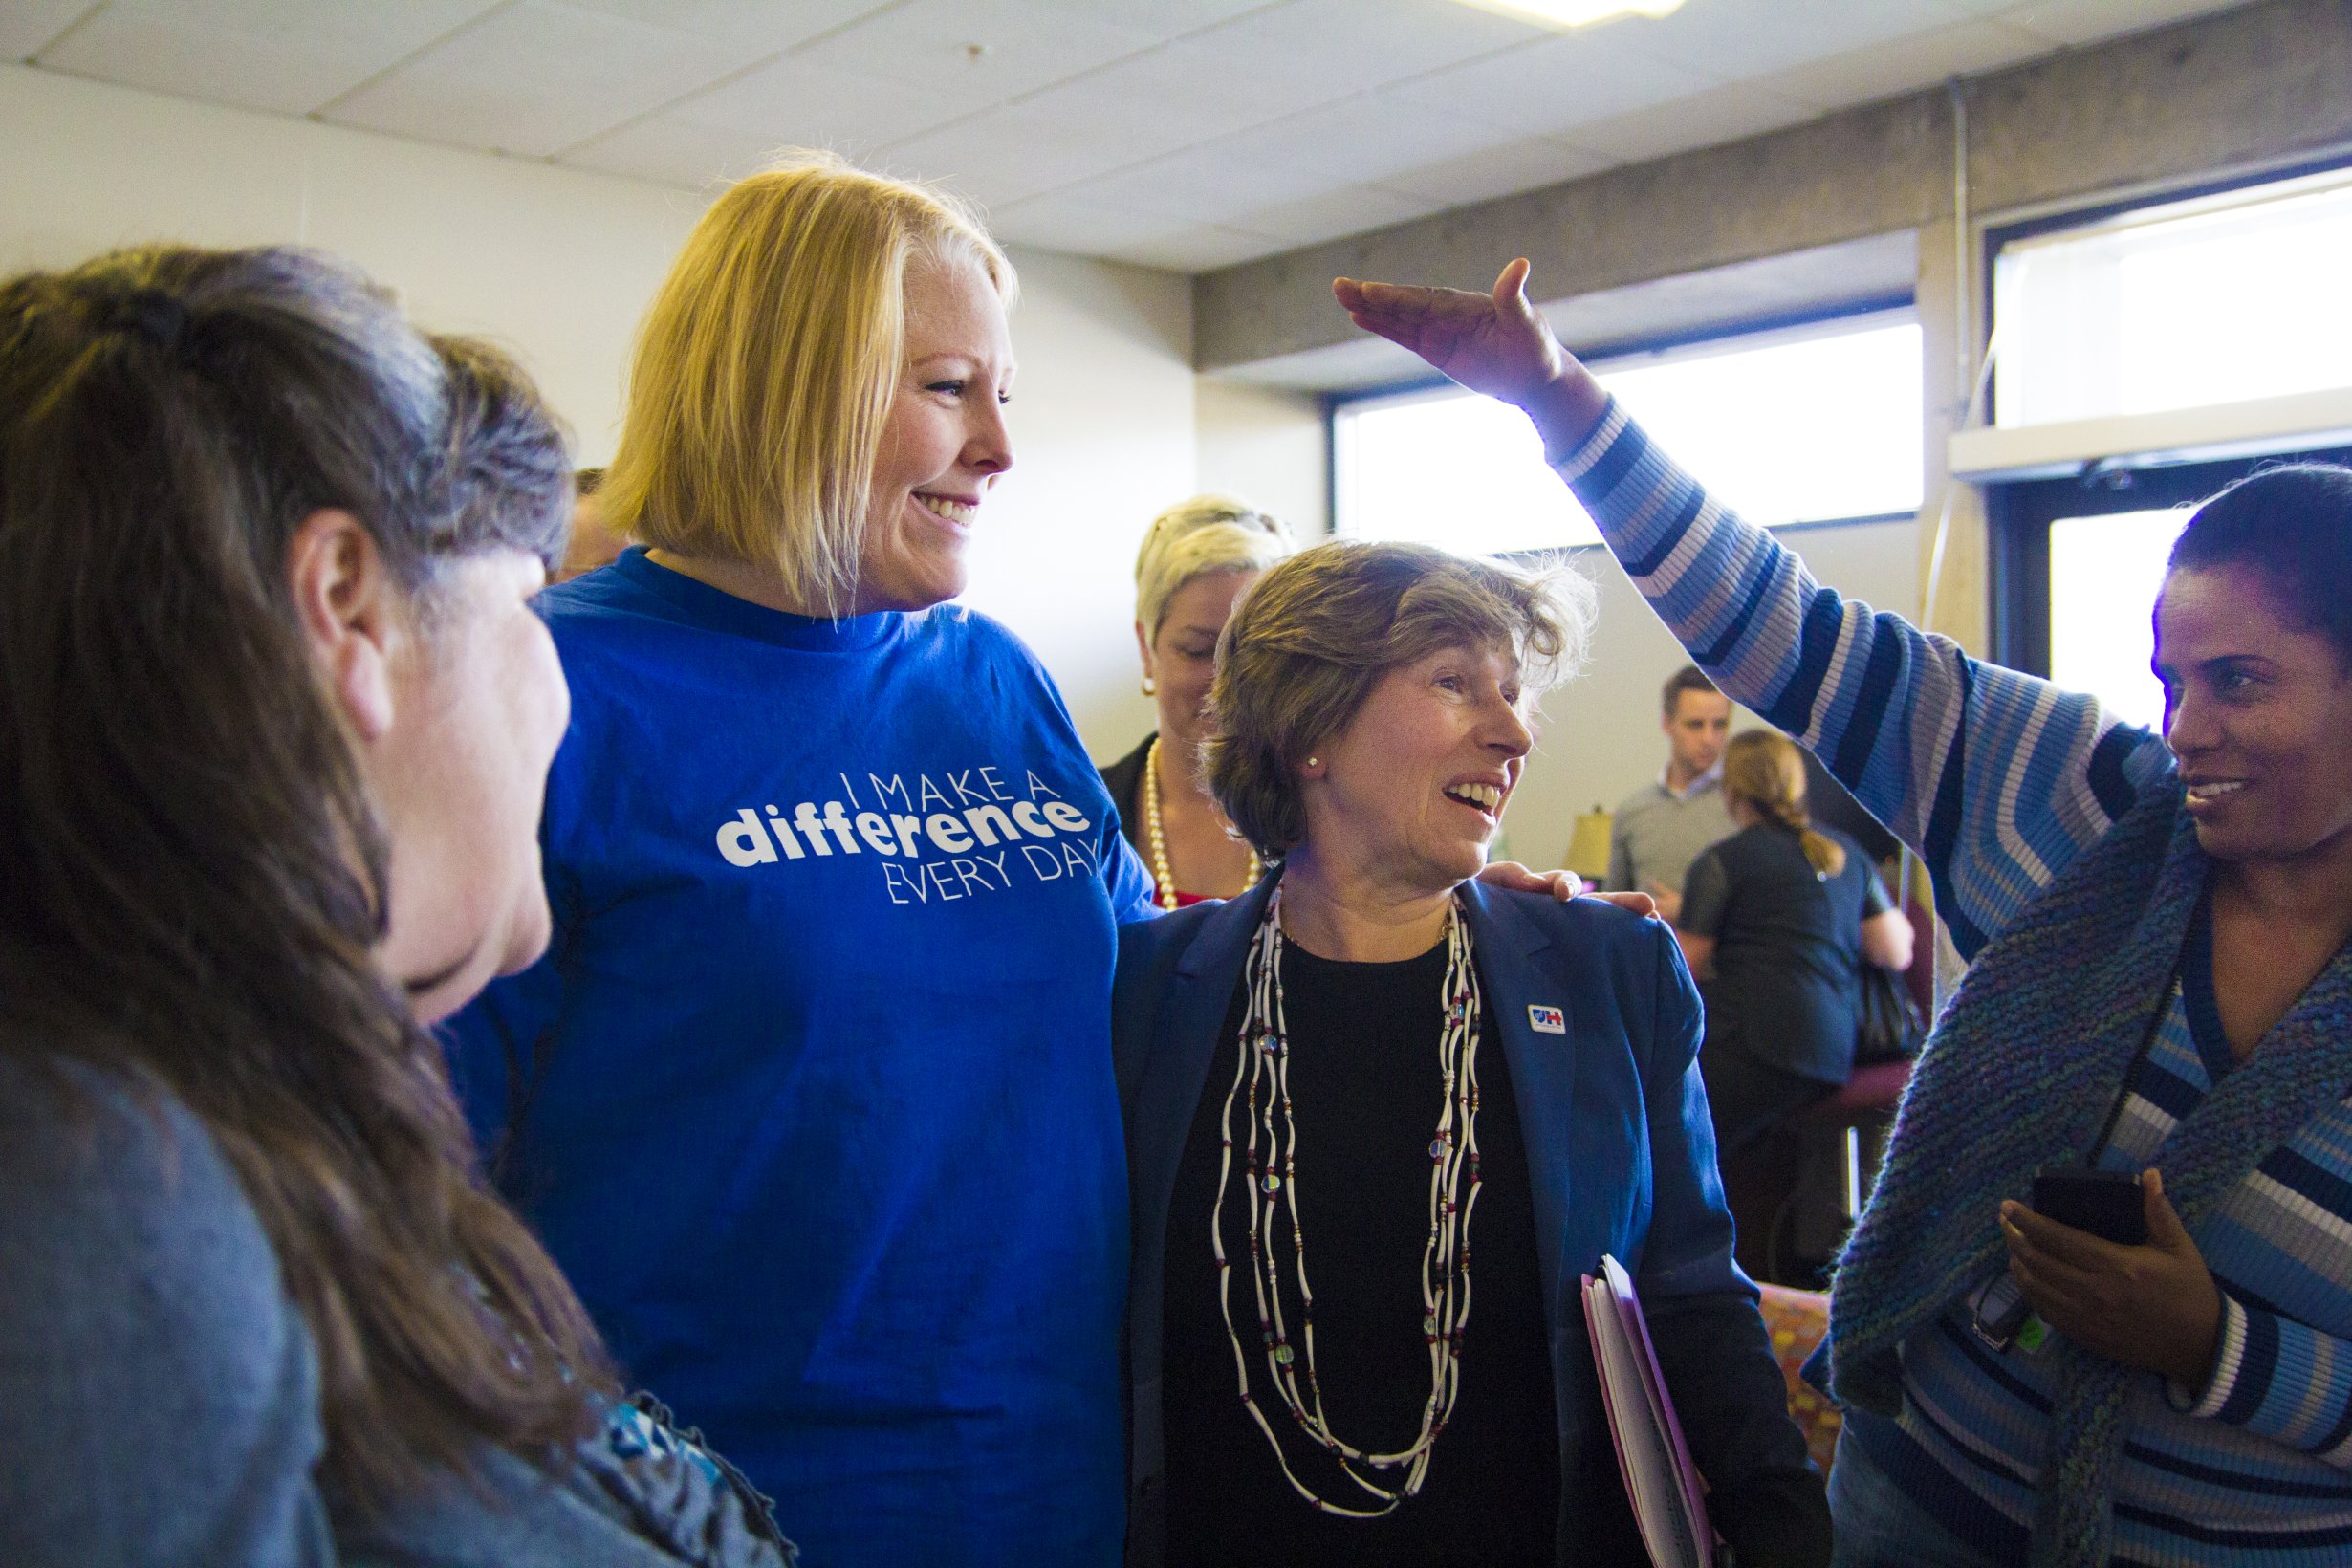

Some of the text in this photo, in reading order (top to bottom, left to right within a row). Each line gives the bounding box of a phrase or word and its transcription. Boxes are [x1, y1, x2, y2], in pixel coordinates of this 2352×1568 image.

[840, 766, 1061, 813] I MAKE A
[716, 800, 1090, 868] difference
[882, 838, 1098, 904] EVERY DAY
